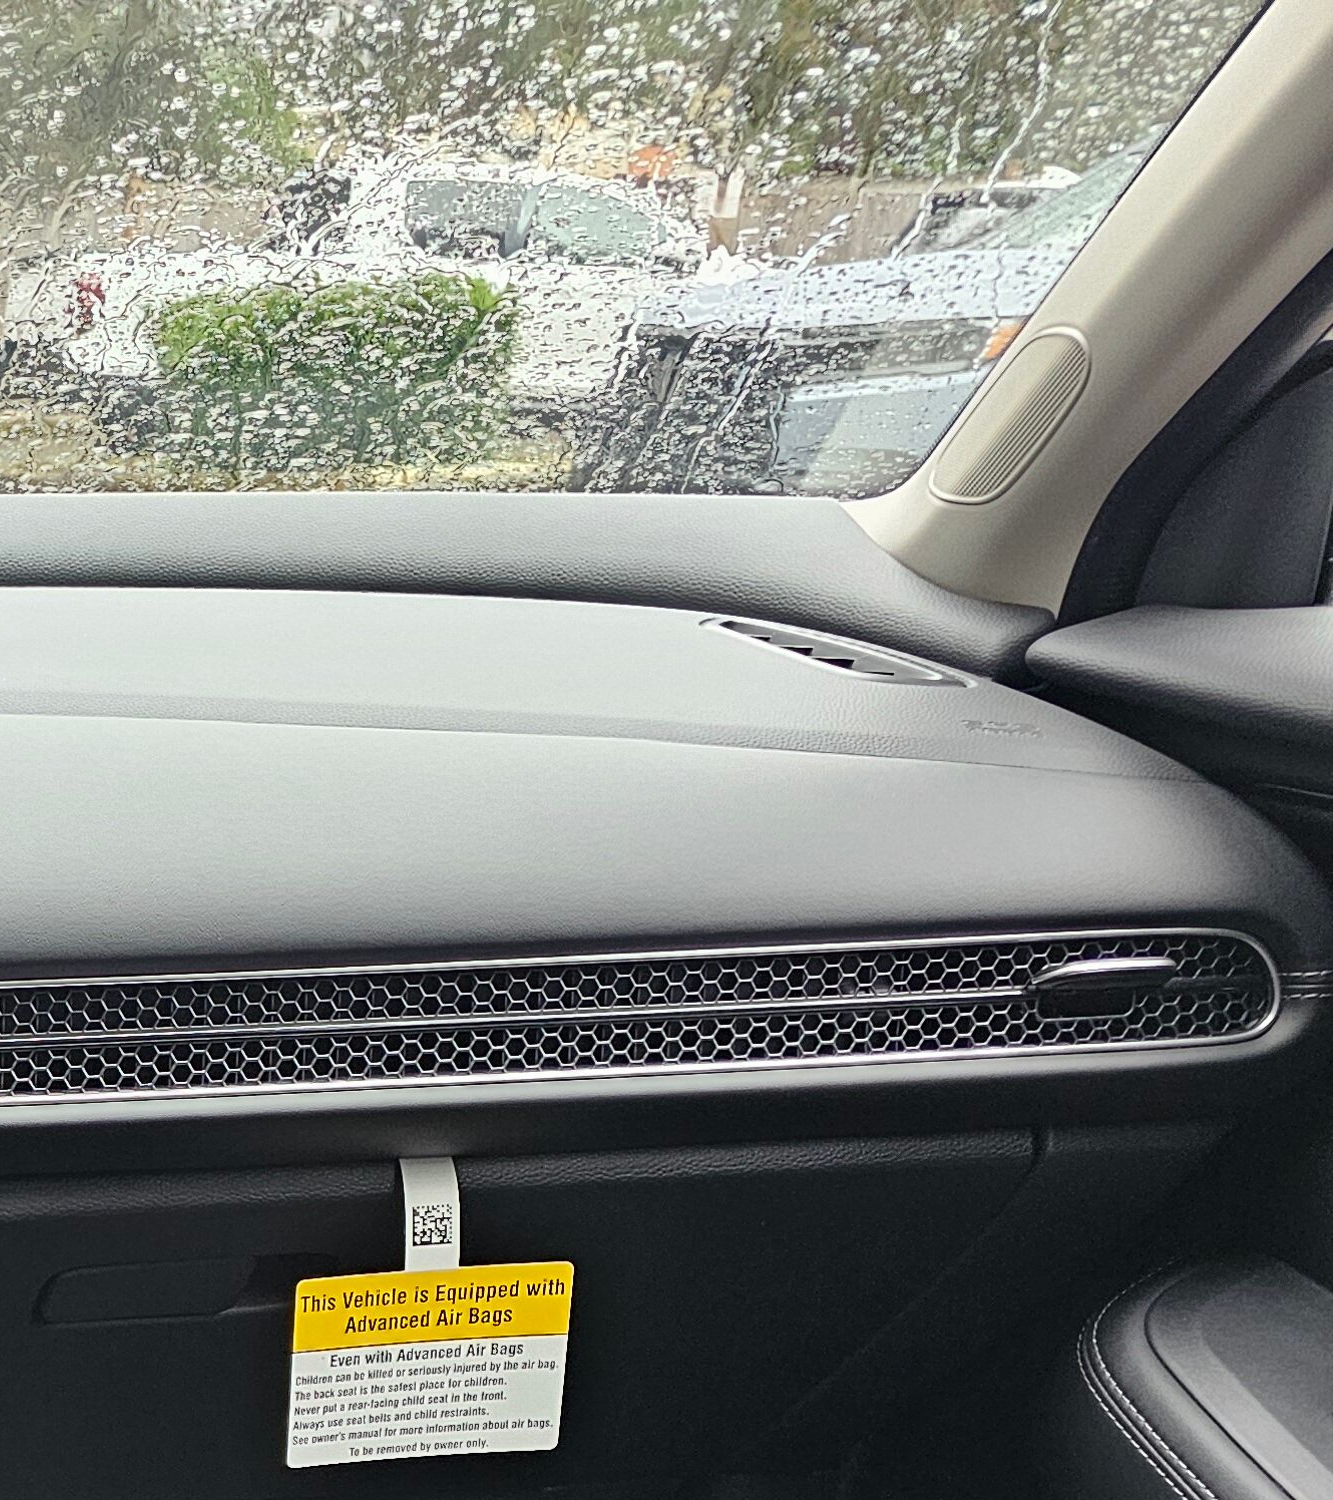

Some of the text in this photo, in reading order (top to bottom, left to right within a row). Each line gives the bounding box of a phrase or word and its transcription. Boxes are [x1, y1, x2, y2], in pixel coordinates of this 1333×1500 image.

[301, 1278, 565, 1313] This Vehicle is Equipped with
[345, 1307, 513, 1334] Advanced Air Bags
[330, 1343, 524, 1367] Even with Advanced Air Bags
[296, 1375, 332, 1386] Children
[336, 1374, 351, 1383] can
[354, 1372, 365, 1381] be
[368, 1369, 393, 1379] killed
[396, 1369, 406, 1378] or
[408, 1364, 451, 1376] seriously
[454, 1362, 486, 1374] injured
[490, 1362, 501, 1373] by
[504, 1361, 518, 1370] the
[522, 1360, 535, 1370] air
[295, 1377, 507, 1401] The back seat is the safest place for children.
[294, 1406, 321, 1416] Never
[323, 1404, 337, 1415] put
[348, 1399, 399, 1411] rear-facing
[402, 1396, 424, 1406] child
[428, 1394, 448, 1404] seat
[451, 1393, 460, 1402] in
[463, 1392, 477, 1401] the
[481, 1391, 507, 1401] front.
[293, 1406, 489, 1431] Always use seat belts and child restraints.
[293, 1418, 553, 1445] See owner's manual for more information about air bags.
[349, 1438, 489, 1457] To be removed by owner only.
